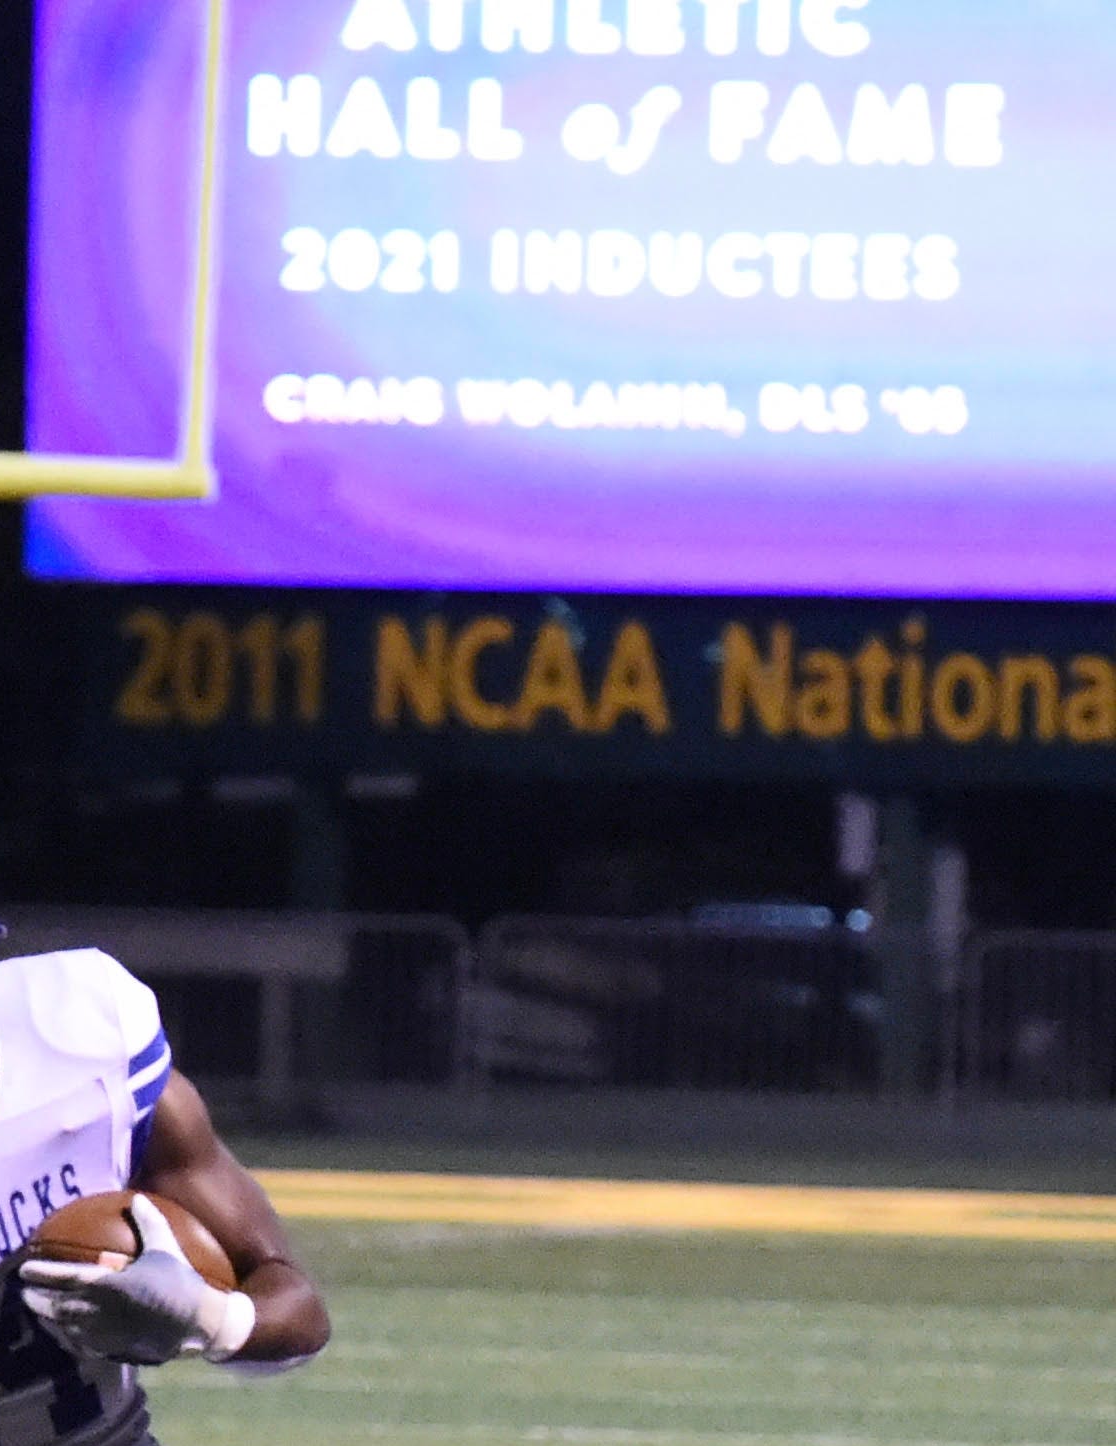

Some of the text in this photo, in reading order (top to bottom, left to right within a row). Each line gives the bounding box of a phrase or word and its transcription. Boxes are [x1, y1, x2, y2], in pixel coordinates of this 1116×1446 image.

[341, 0, 871, 56] ATHLETIC
[248, 74, 1005, 175] HALL of FAME
[279, 228, 961, 301] 2021 INDUCTEES
[115, 609, 1116, 742] 2011 NCAA Nationa
